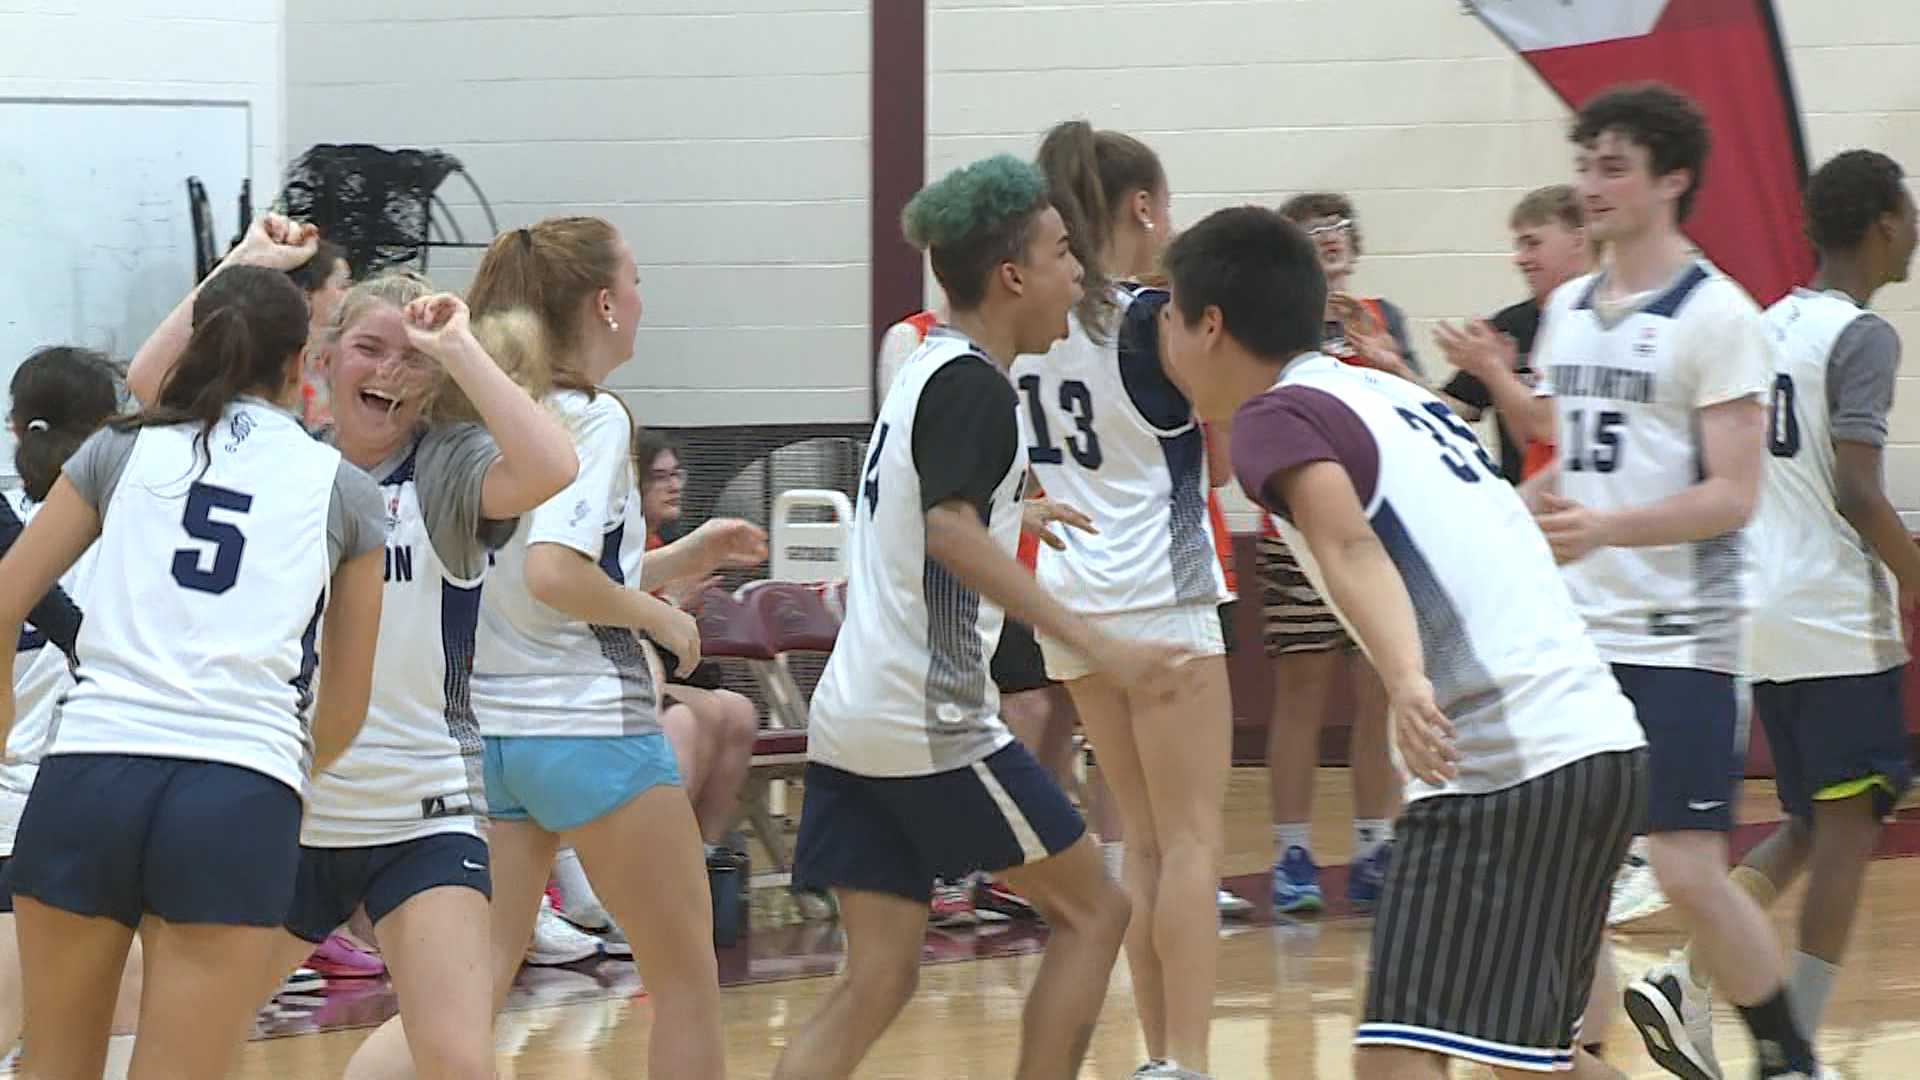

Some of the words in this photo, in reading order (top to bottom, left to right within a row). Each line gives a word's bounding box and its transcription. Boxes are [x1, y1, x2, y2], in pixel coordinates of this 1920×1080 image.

[1018, 374, 1103, 470] 13
[1563, 408, 1630, 474] 15
[170, 480, 255, 596] 5
